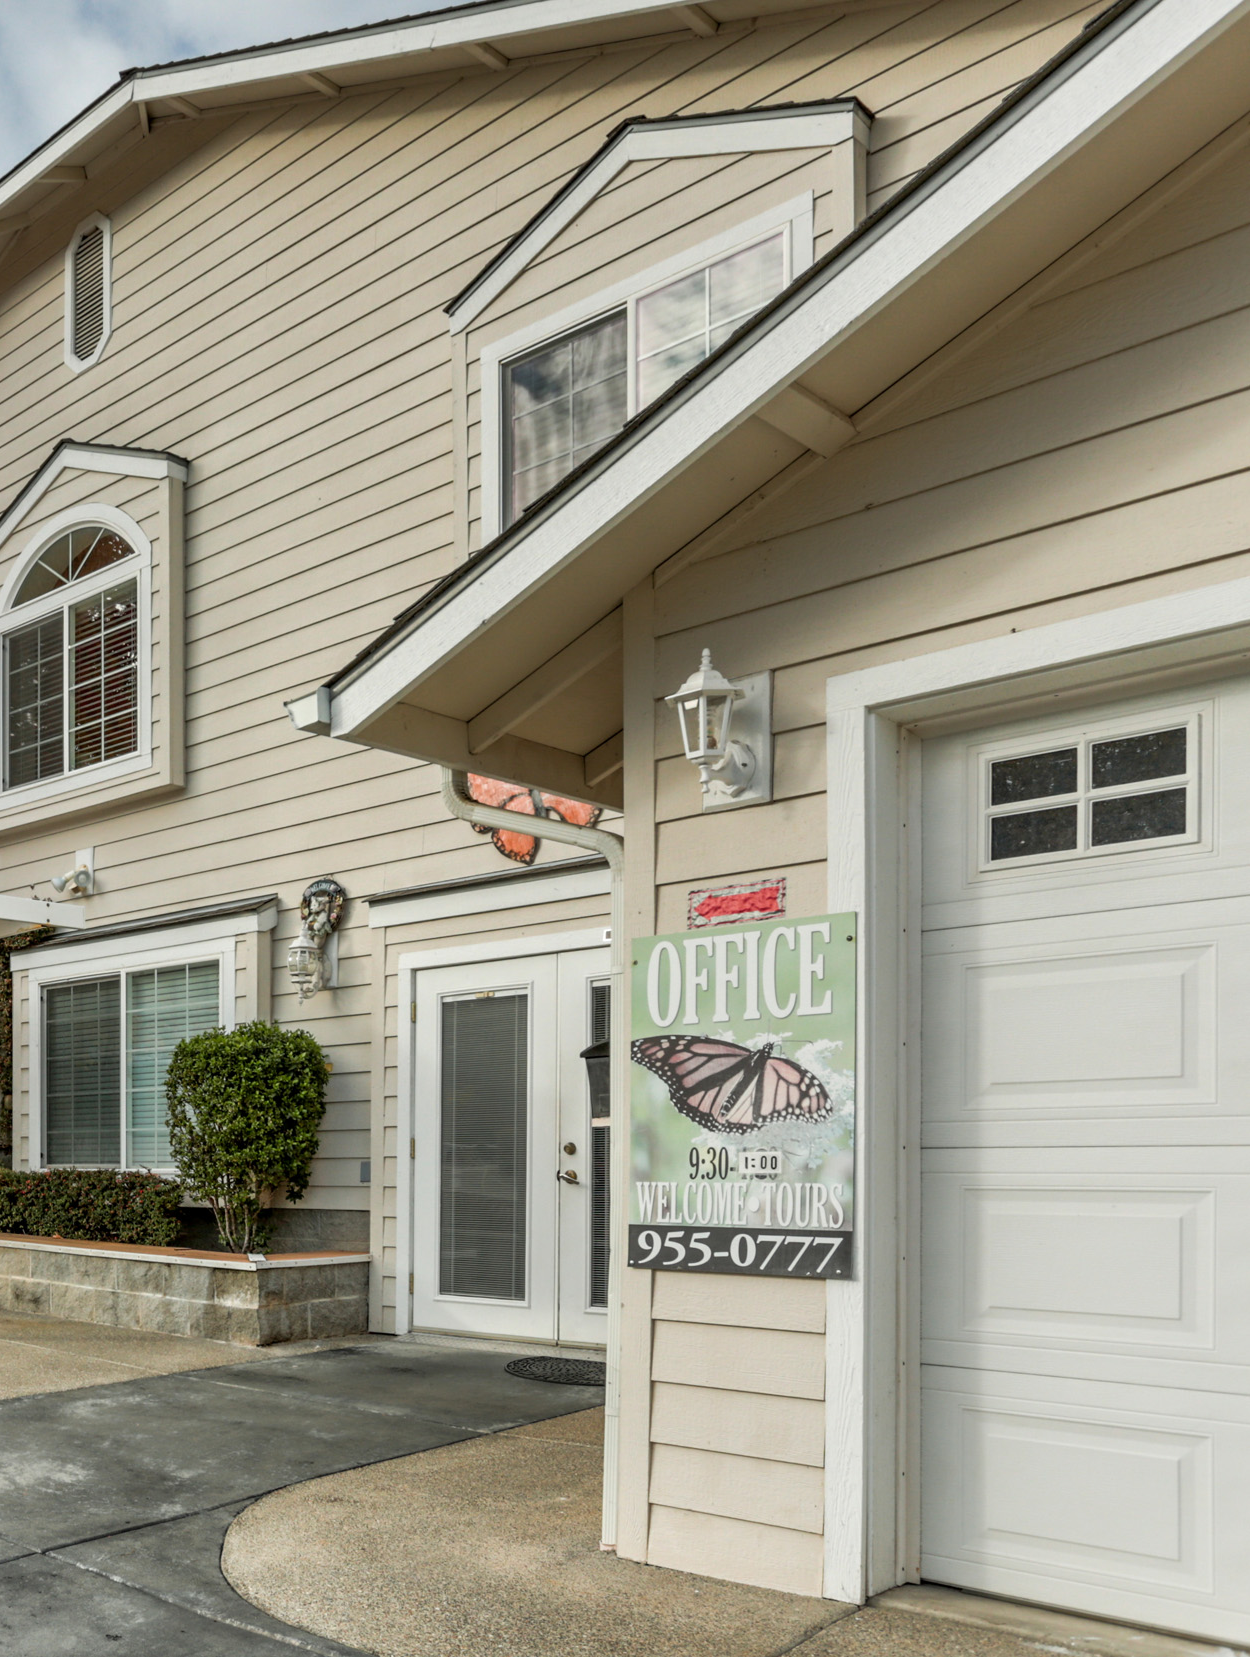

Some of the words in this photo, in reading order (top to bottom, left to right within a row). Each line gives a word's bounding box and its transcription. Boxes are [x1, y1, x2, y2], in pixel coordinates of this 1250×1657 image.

[647, 921, 832, 1027] OFFICE
[635, 1181, 748, 1225] WELCOME
[761, 1182, 845, 1229] TOURS
[637, 1230, 844, 1273] 955-0777
